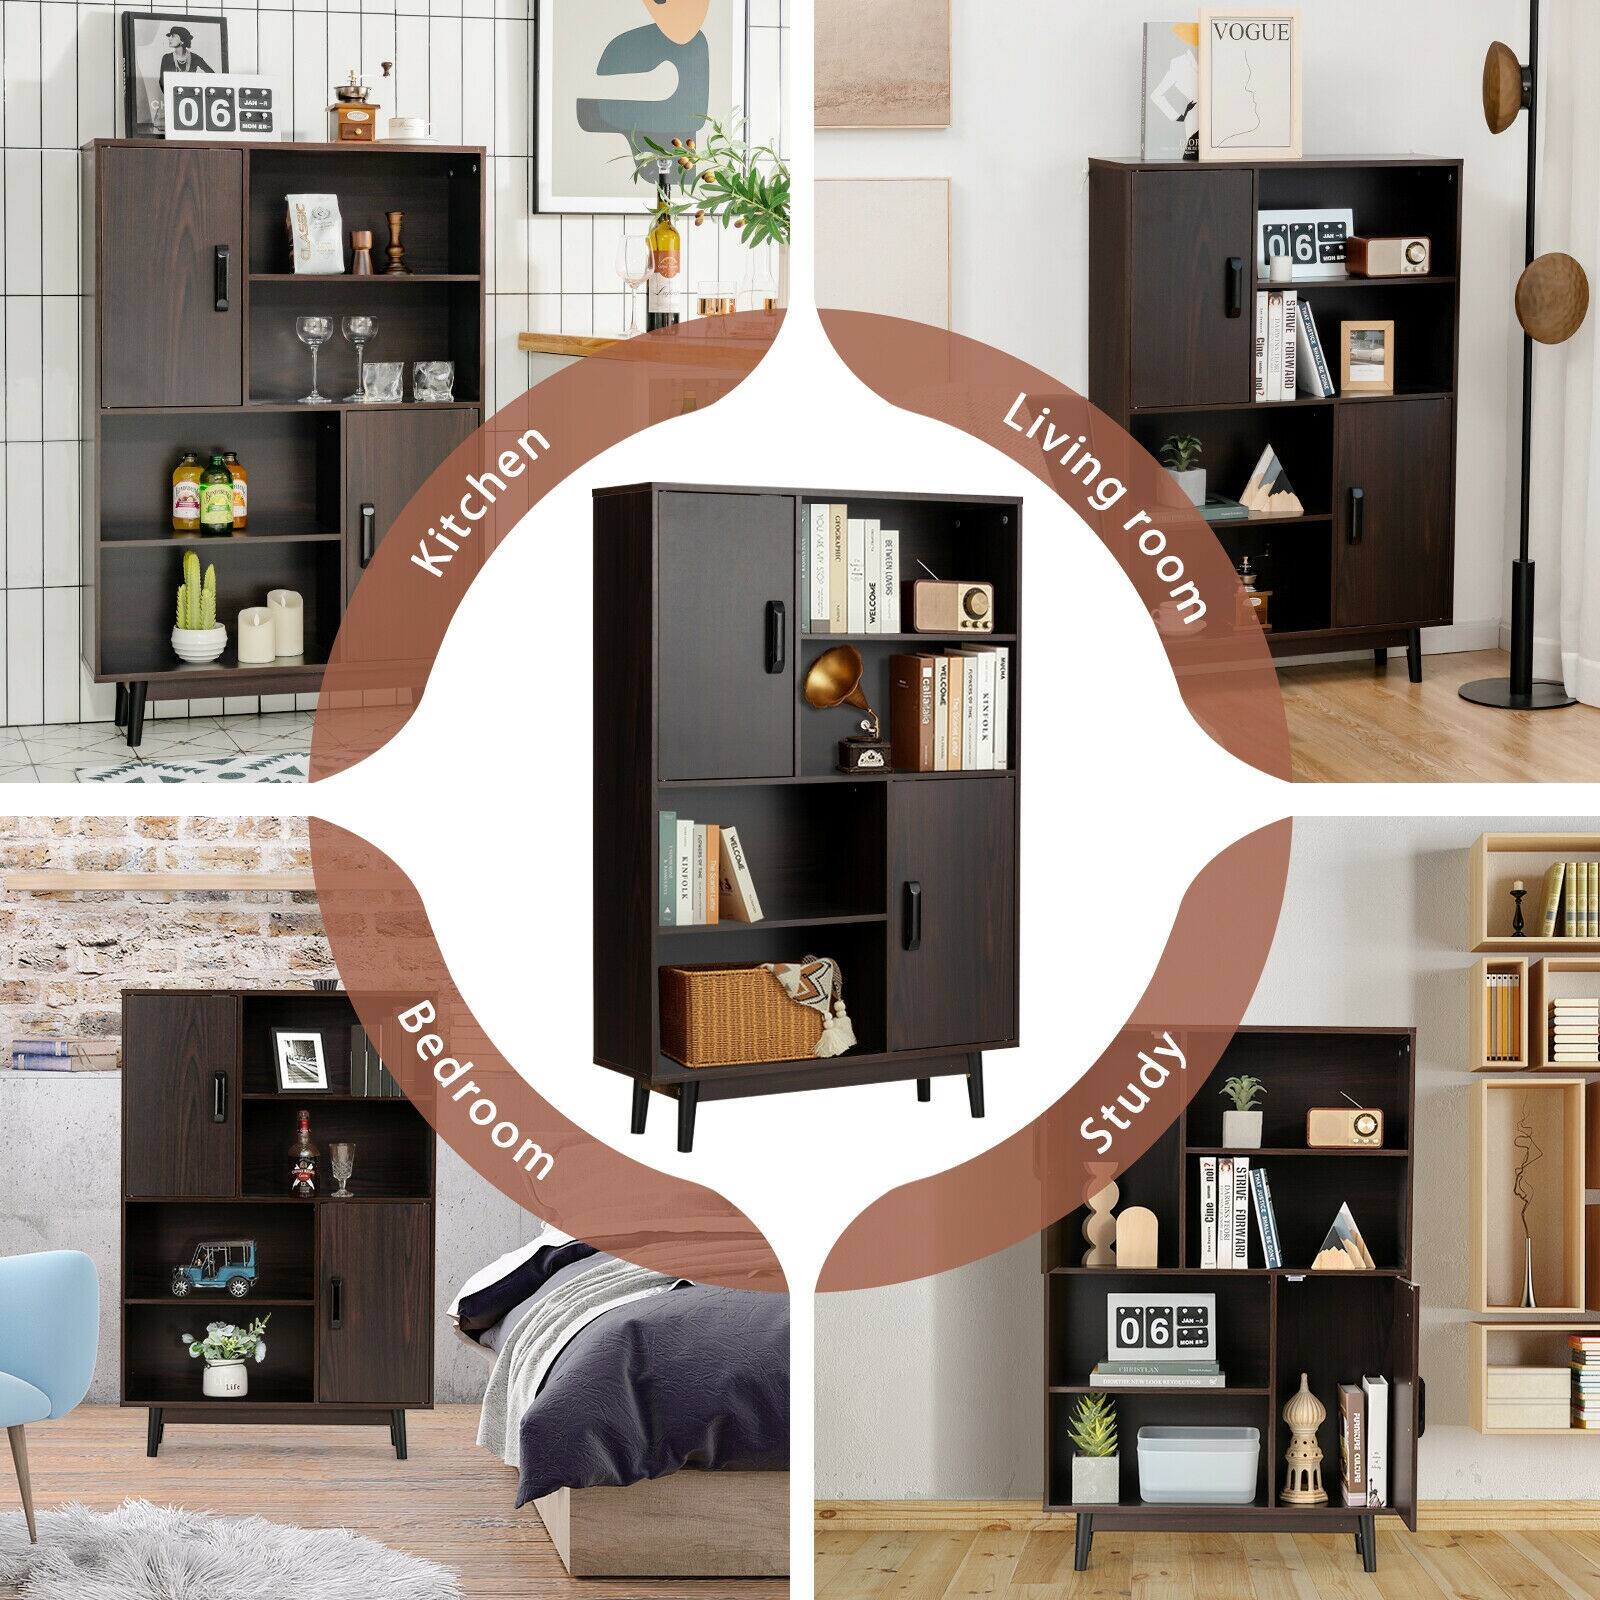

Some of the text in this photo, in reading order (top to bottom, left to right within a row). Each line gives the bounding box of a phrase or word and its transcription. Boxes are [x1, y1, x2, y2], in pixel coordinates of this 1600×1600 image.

[1213, 22, 1290, 41] VOGUE
[1284, 300, 1296, 389] STRIVE FORWARD
[1305, 321, 1316, 345] JUSTICE
[1312, 346, 1321, 365] SHALL
[1320, 374, 1330, 390] DONE
[885, 539, 893, 570] BETWEEN
[885, 571, 893, 596] LOVERS
[729, 835, 746, 872] WELCOME
[1203, 1162, 1214, 1223] Cine noi?
[1235, 1167, 1247, 1258] STRIVE FORWARD
[1254, 1173, 1275, 1262] THAT JUSTICE SHALL BE DONE
[226, 1383, 241, 1391] Life
[1354, 1452, 1362, 1484] CULTURE
